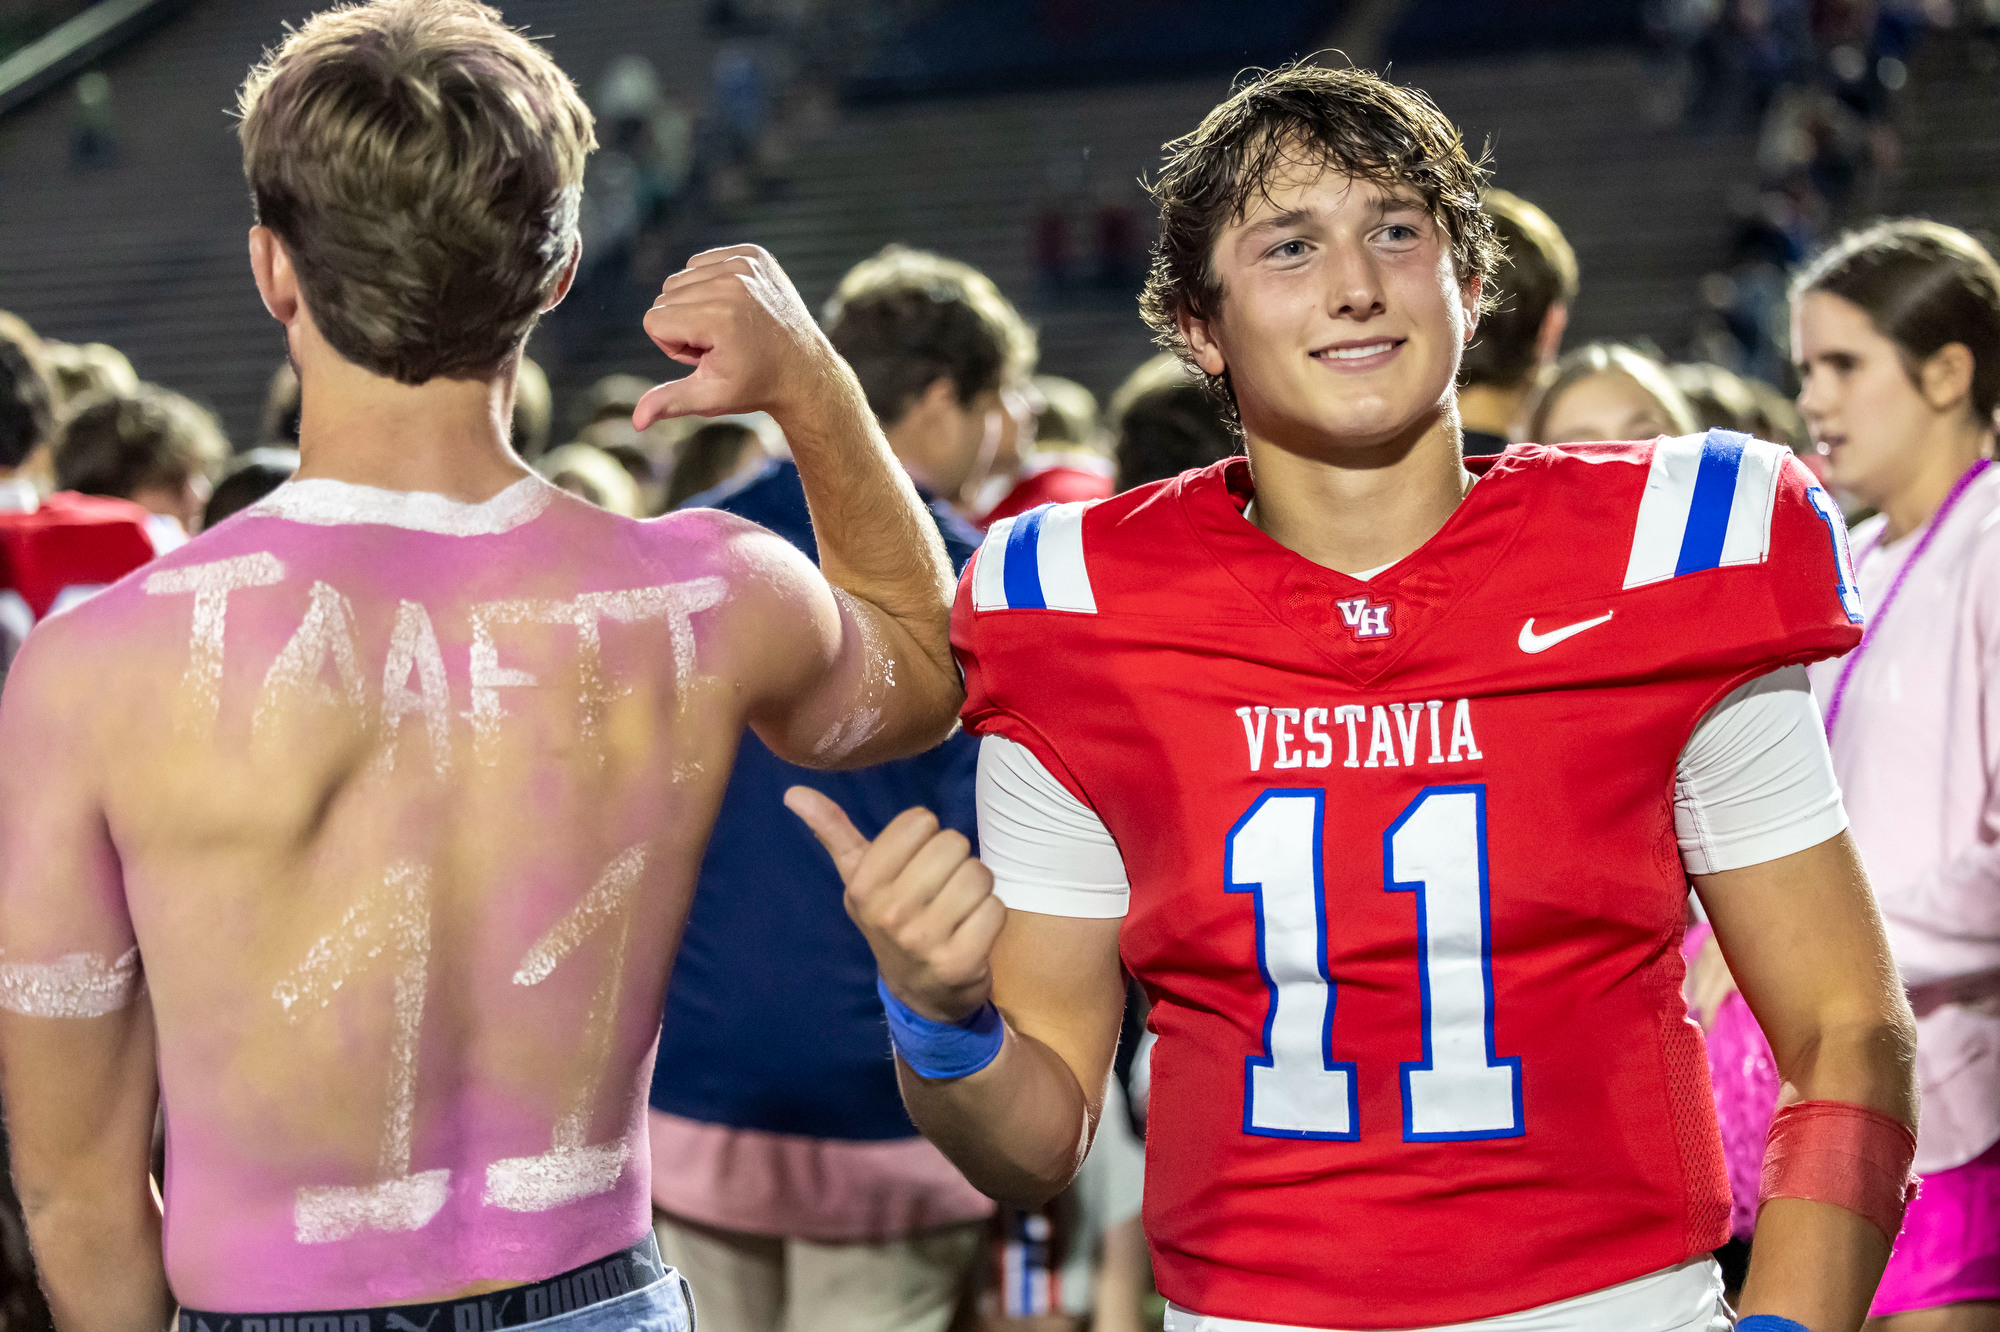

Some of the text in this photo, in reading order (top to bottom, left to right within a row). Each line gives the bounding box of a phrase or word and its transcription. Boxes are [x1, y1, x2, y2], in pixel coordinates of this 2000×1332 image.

[1336, 597, 1394, 638] VH
[1236, 699, 1482, 771] VESTAVIA
[272, 841, 647, 1244] 11
[1223, 784, 1526, 1142] 11
